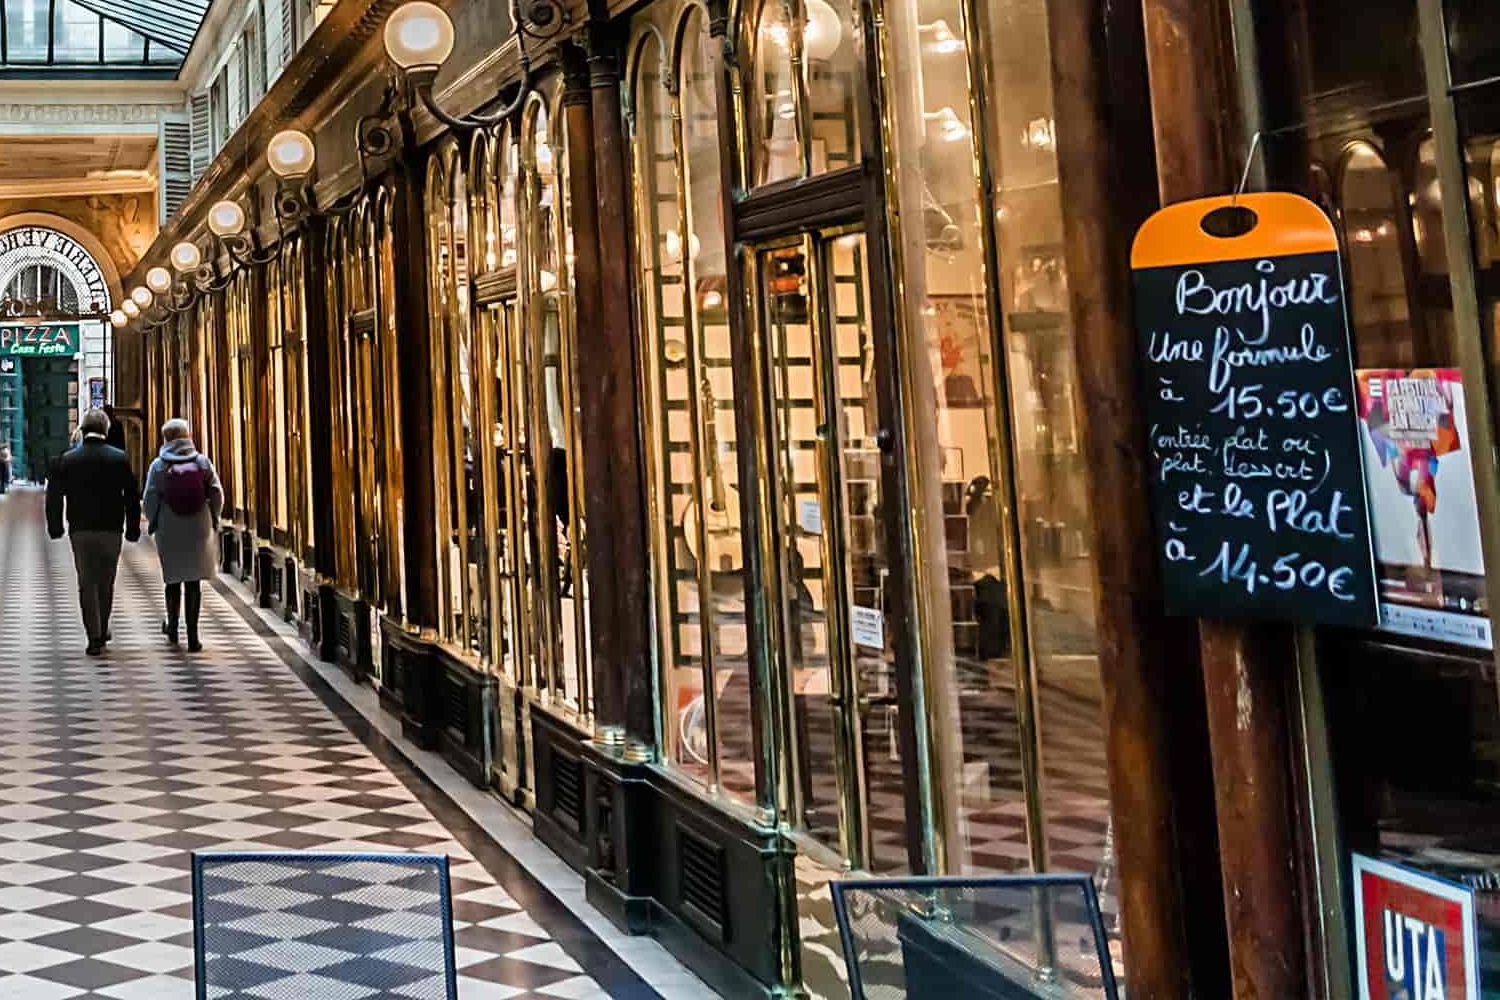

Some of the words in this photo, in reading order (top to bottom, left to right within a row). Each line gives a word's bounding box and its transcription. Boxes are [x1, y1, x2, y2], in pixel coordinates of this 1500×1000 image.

[1, 326, 74, 349] PIZZA
[1176, 260, 1338, 345] Bonjour
[1149, 331, 1203, 363] Une
[1208, 322, 1333, 393] formule
[1160, 376, 1184, 401] à
[1209, 384, 1349, 420] 15.50€
[1178, 483, 1215, 513] et
[1220, 482, 1255, 519] le
[1266, 489, 1354, 538] Plat
[1165, 521, 1197, 561] à
[1199, 541, 1356, 601] 14.50€
[1383, 908, 1447, 1000] UTA
